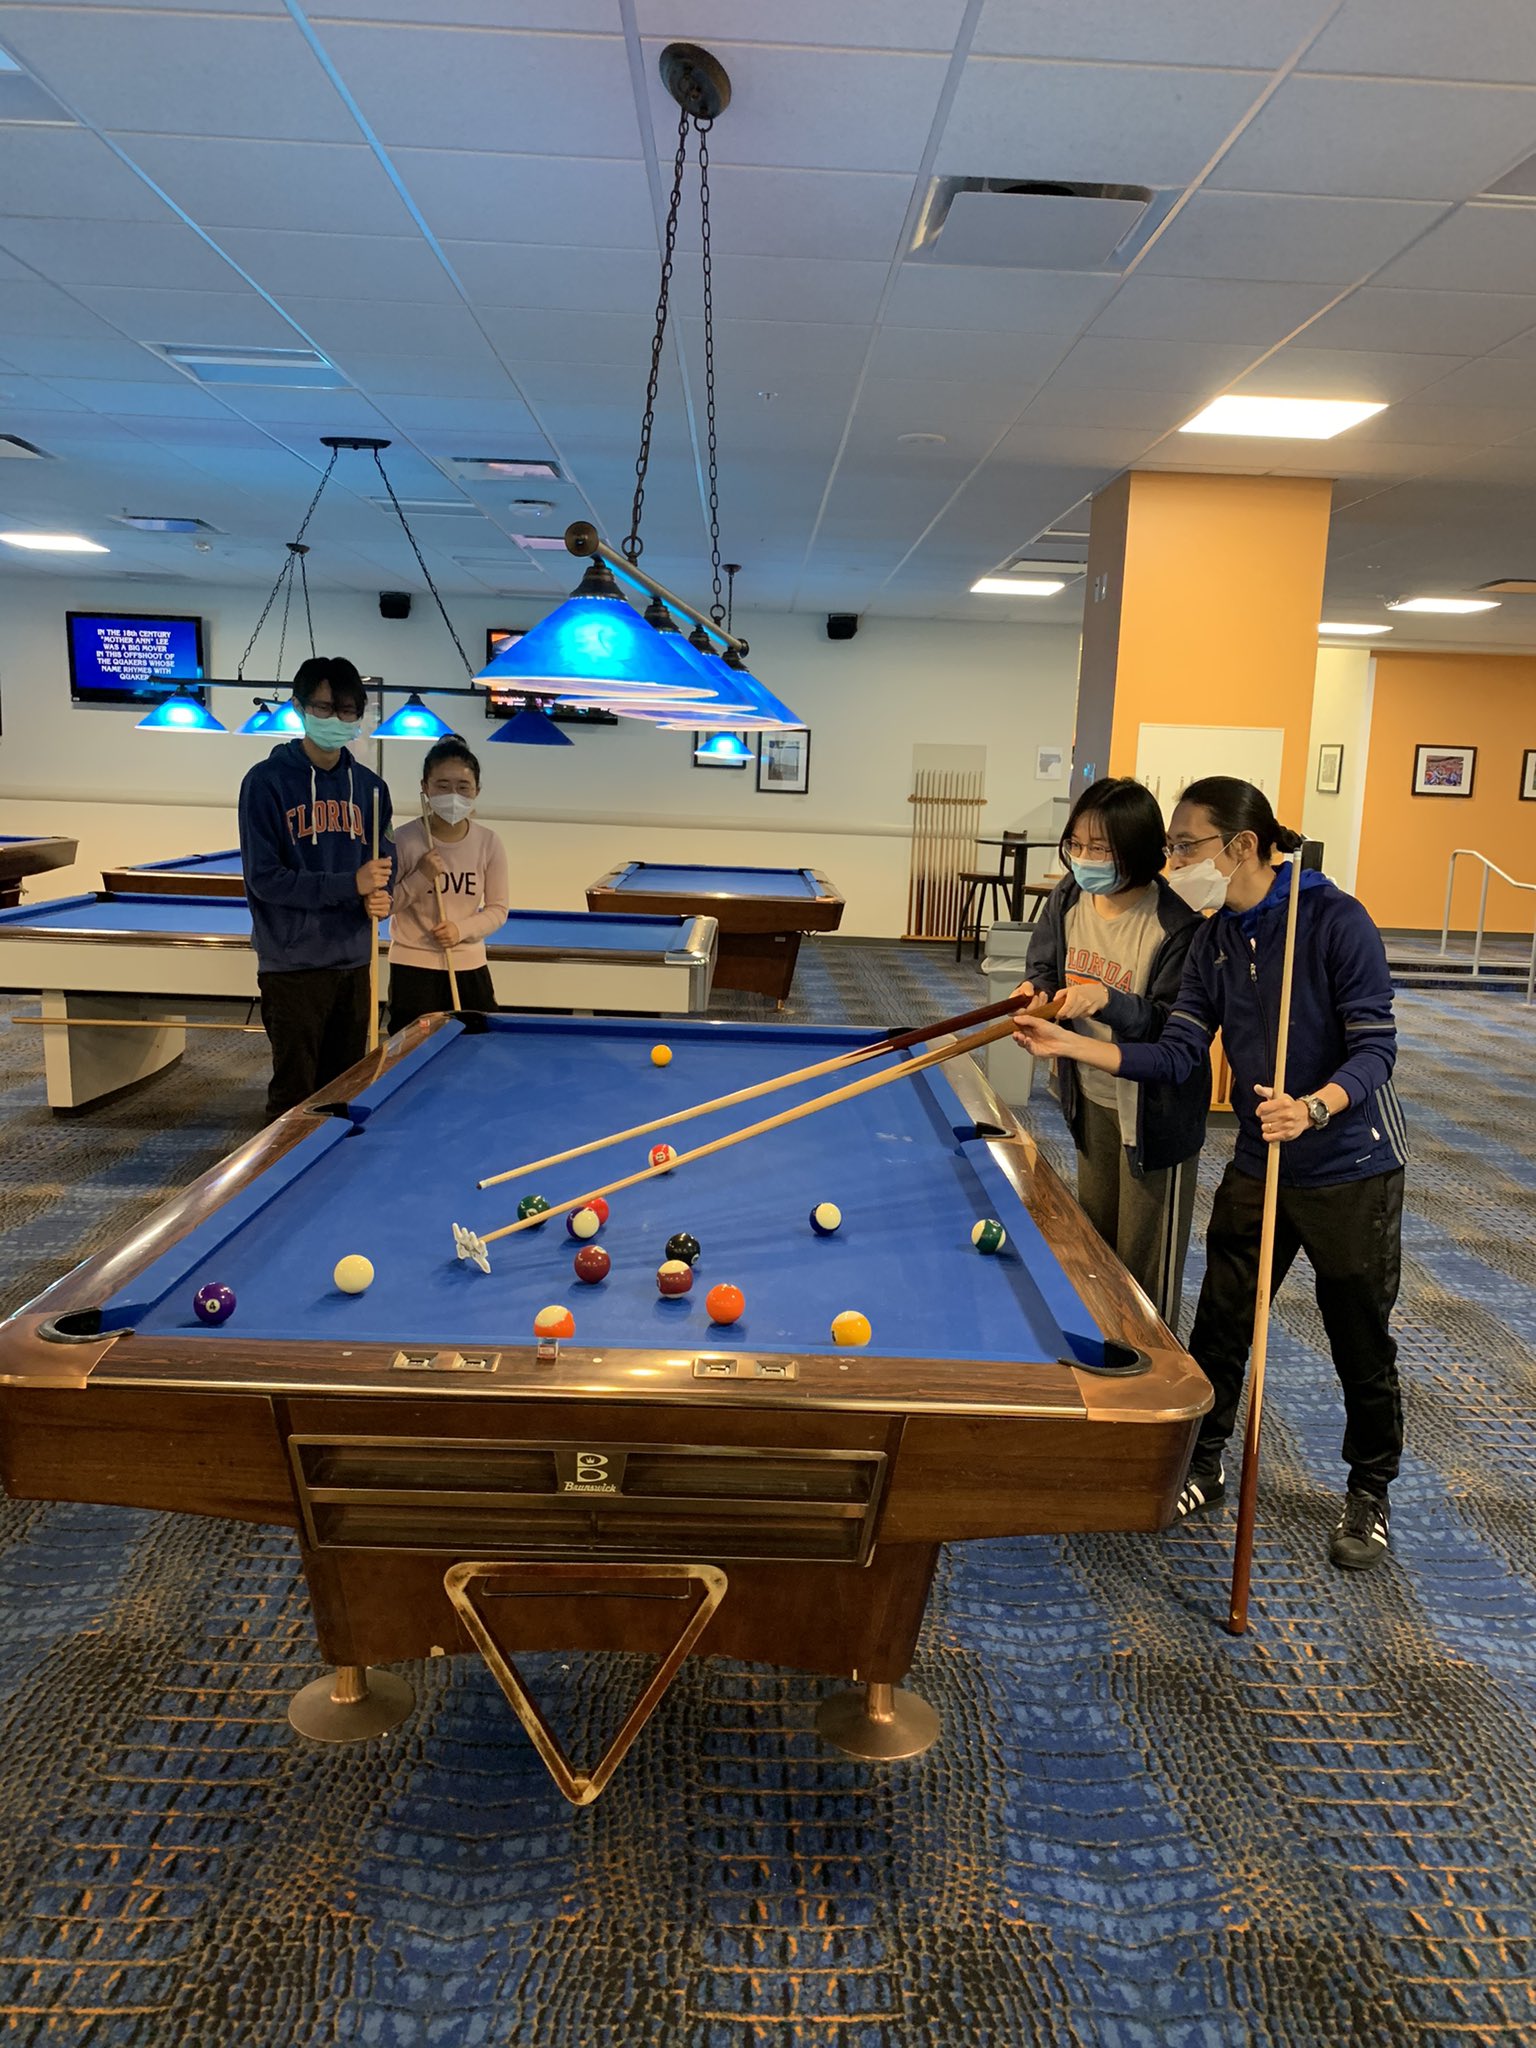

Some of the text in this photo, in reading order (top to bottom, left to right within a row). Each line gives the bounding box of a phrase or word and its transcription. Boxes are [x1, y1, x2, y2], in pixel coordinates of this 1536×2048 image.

[139, 630, 171, 638] CENTURY
[123, 652, 163, 660] OFFSHOOT
[149, 660, 175, 668] WHOSE
[123, 666, 153, 674] RHYMES
[427, 871, 477, 896] OVE
[564, 1481, 617, 1493] Brunswick
